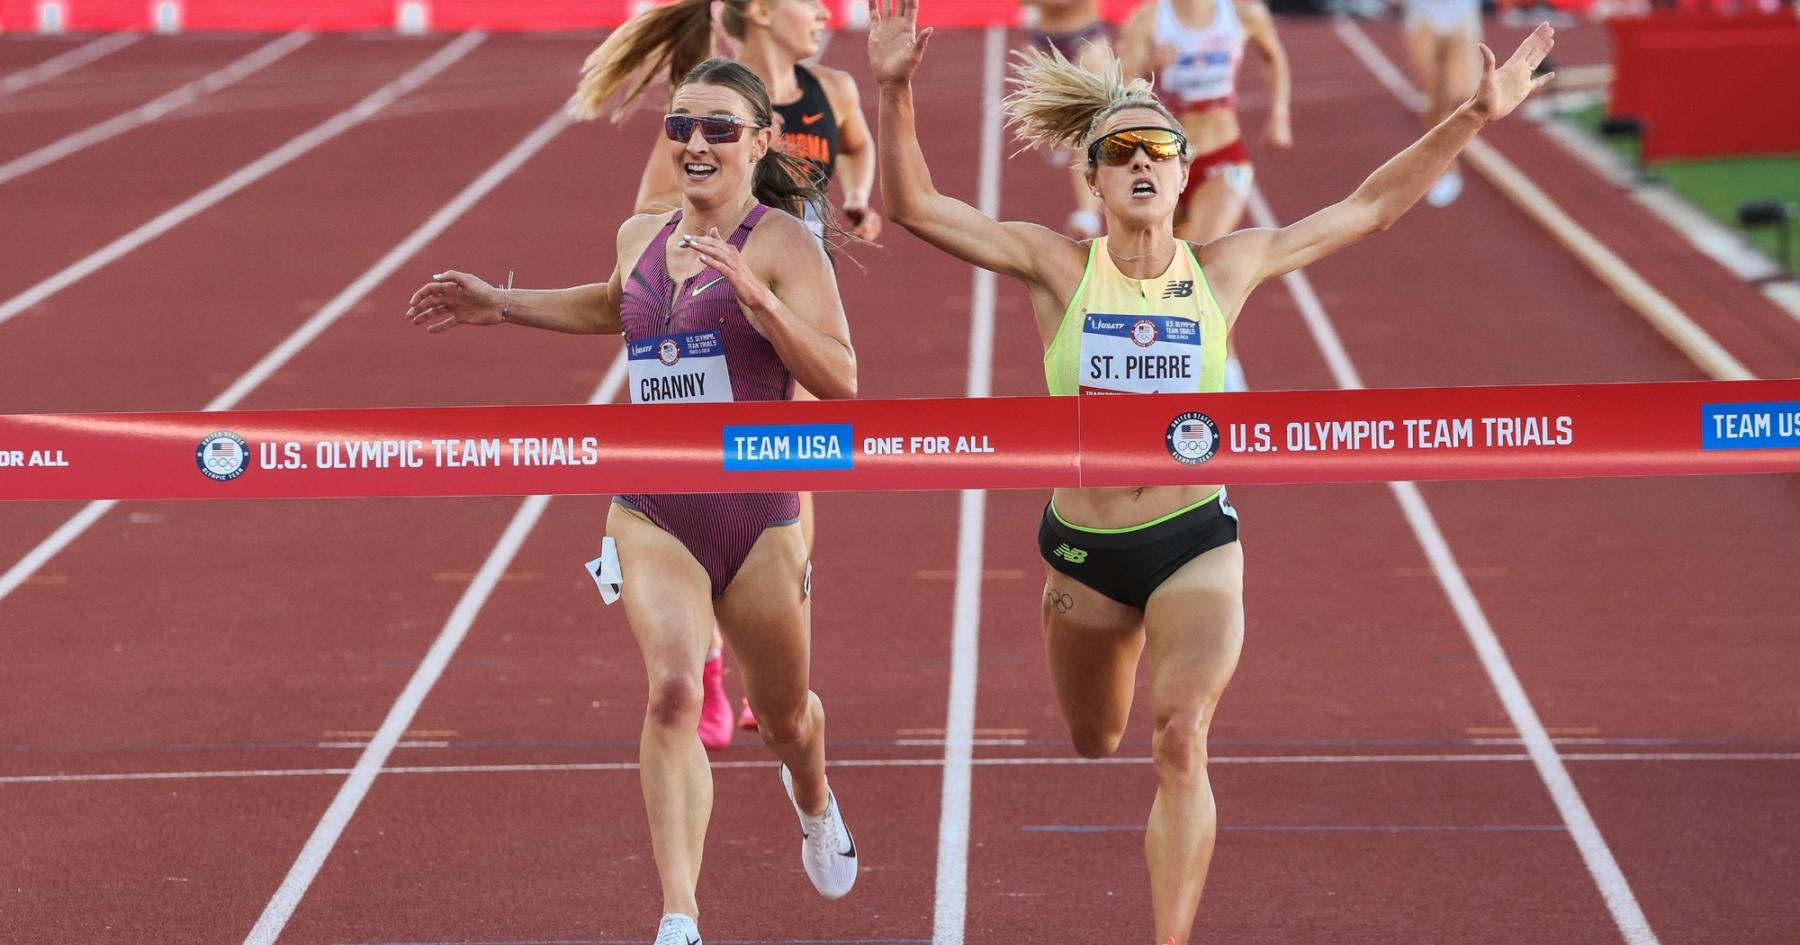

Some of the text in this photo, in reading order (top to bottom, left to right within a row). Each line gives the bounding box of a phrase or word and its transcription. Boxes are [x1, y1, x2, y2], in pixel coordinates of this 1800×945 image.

[1090, 355, 1191, 379] ST. PIERRE
[641, 372, 705, 402] CRANNY
[1230, 416, 1573, 453] U.S. OLYMPIC TEAM TRIALS
[1713, 413, 1771, 439] TEAM
[260, 437, 598, 470] U.S. OLYMPIC TEAM TRIALS
[734, 435, 842, 460] TEAM USA
[863, 436, 994, 455] ONE FOR ALL
[28, 450, 69, 467] ALL
